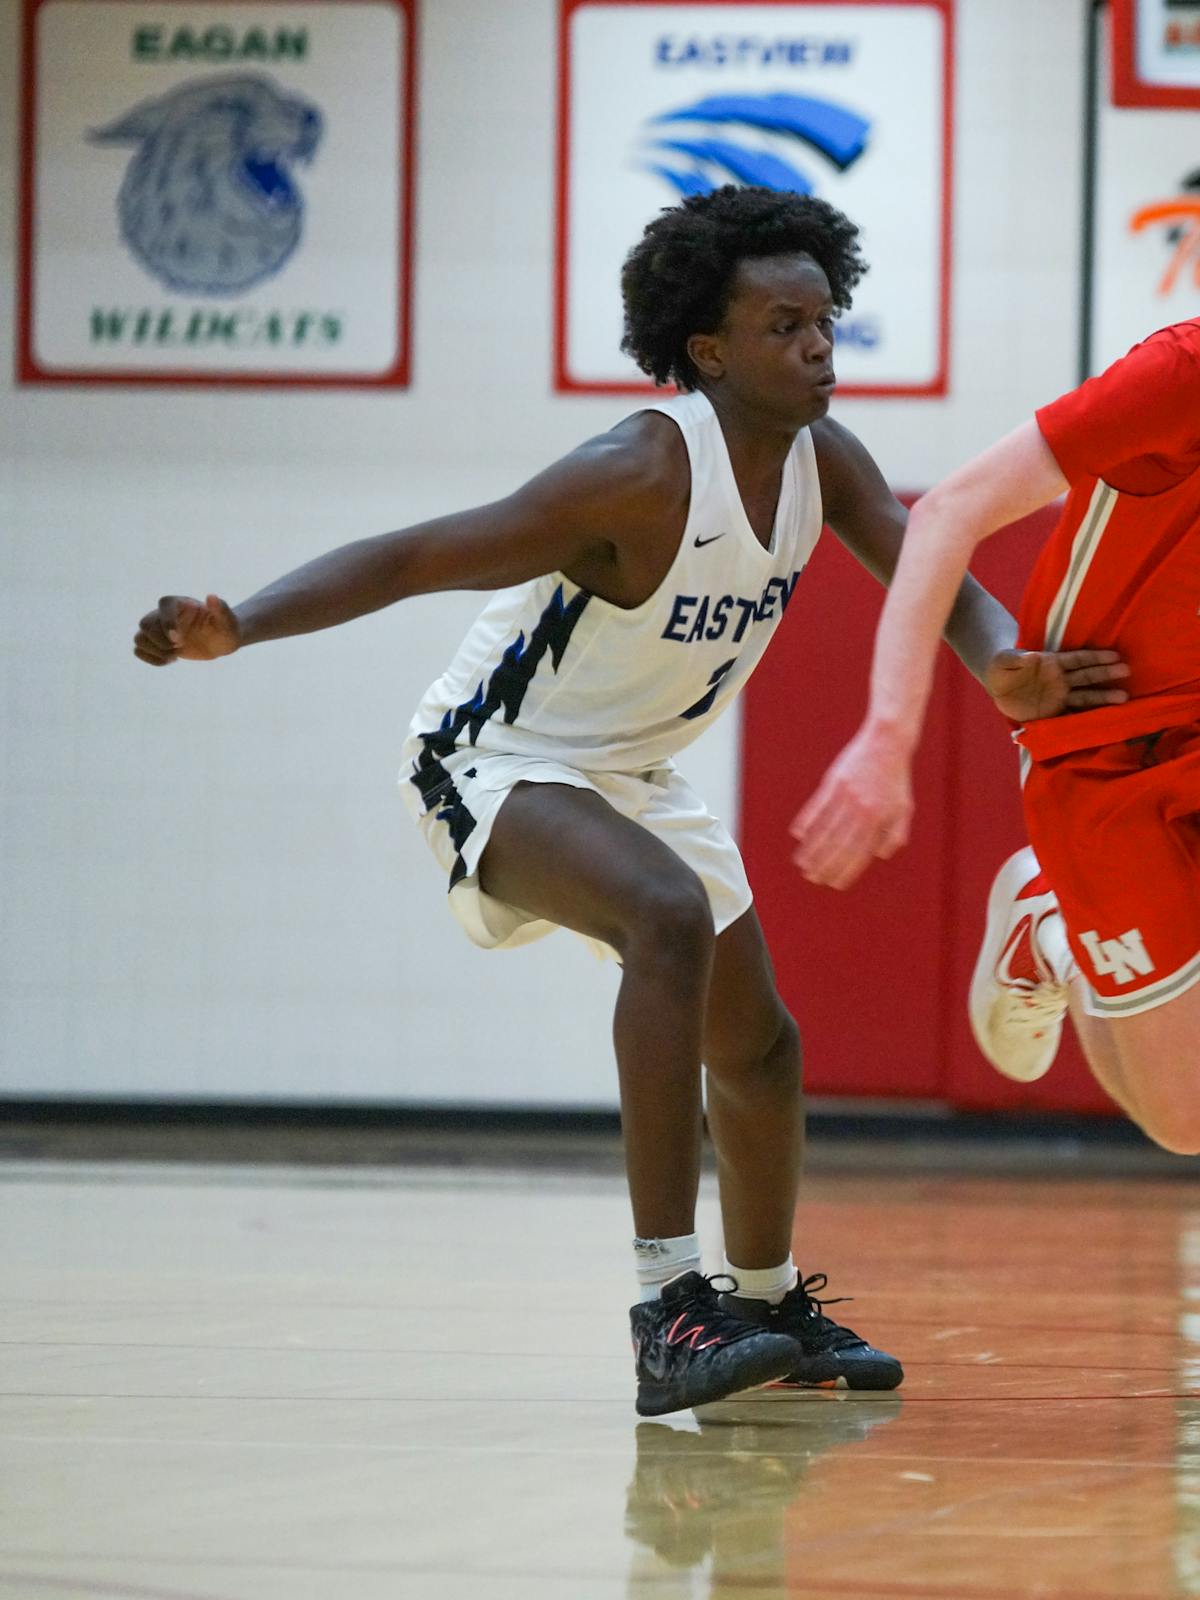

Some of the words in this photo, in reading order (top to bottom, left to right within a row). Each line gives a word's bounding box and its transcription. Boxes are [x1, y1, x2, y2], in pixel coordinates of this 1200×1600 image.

[131, 25, 309, 62] EAGAN
[655, 36, 858, 66] EASTVIEW
[88, 308, 344, 345] WILDCATS
[1077, 928, 1156, 986] LN
